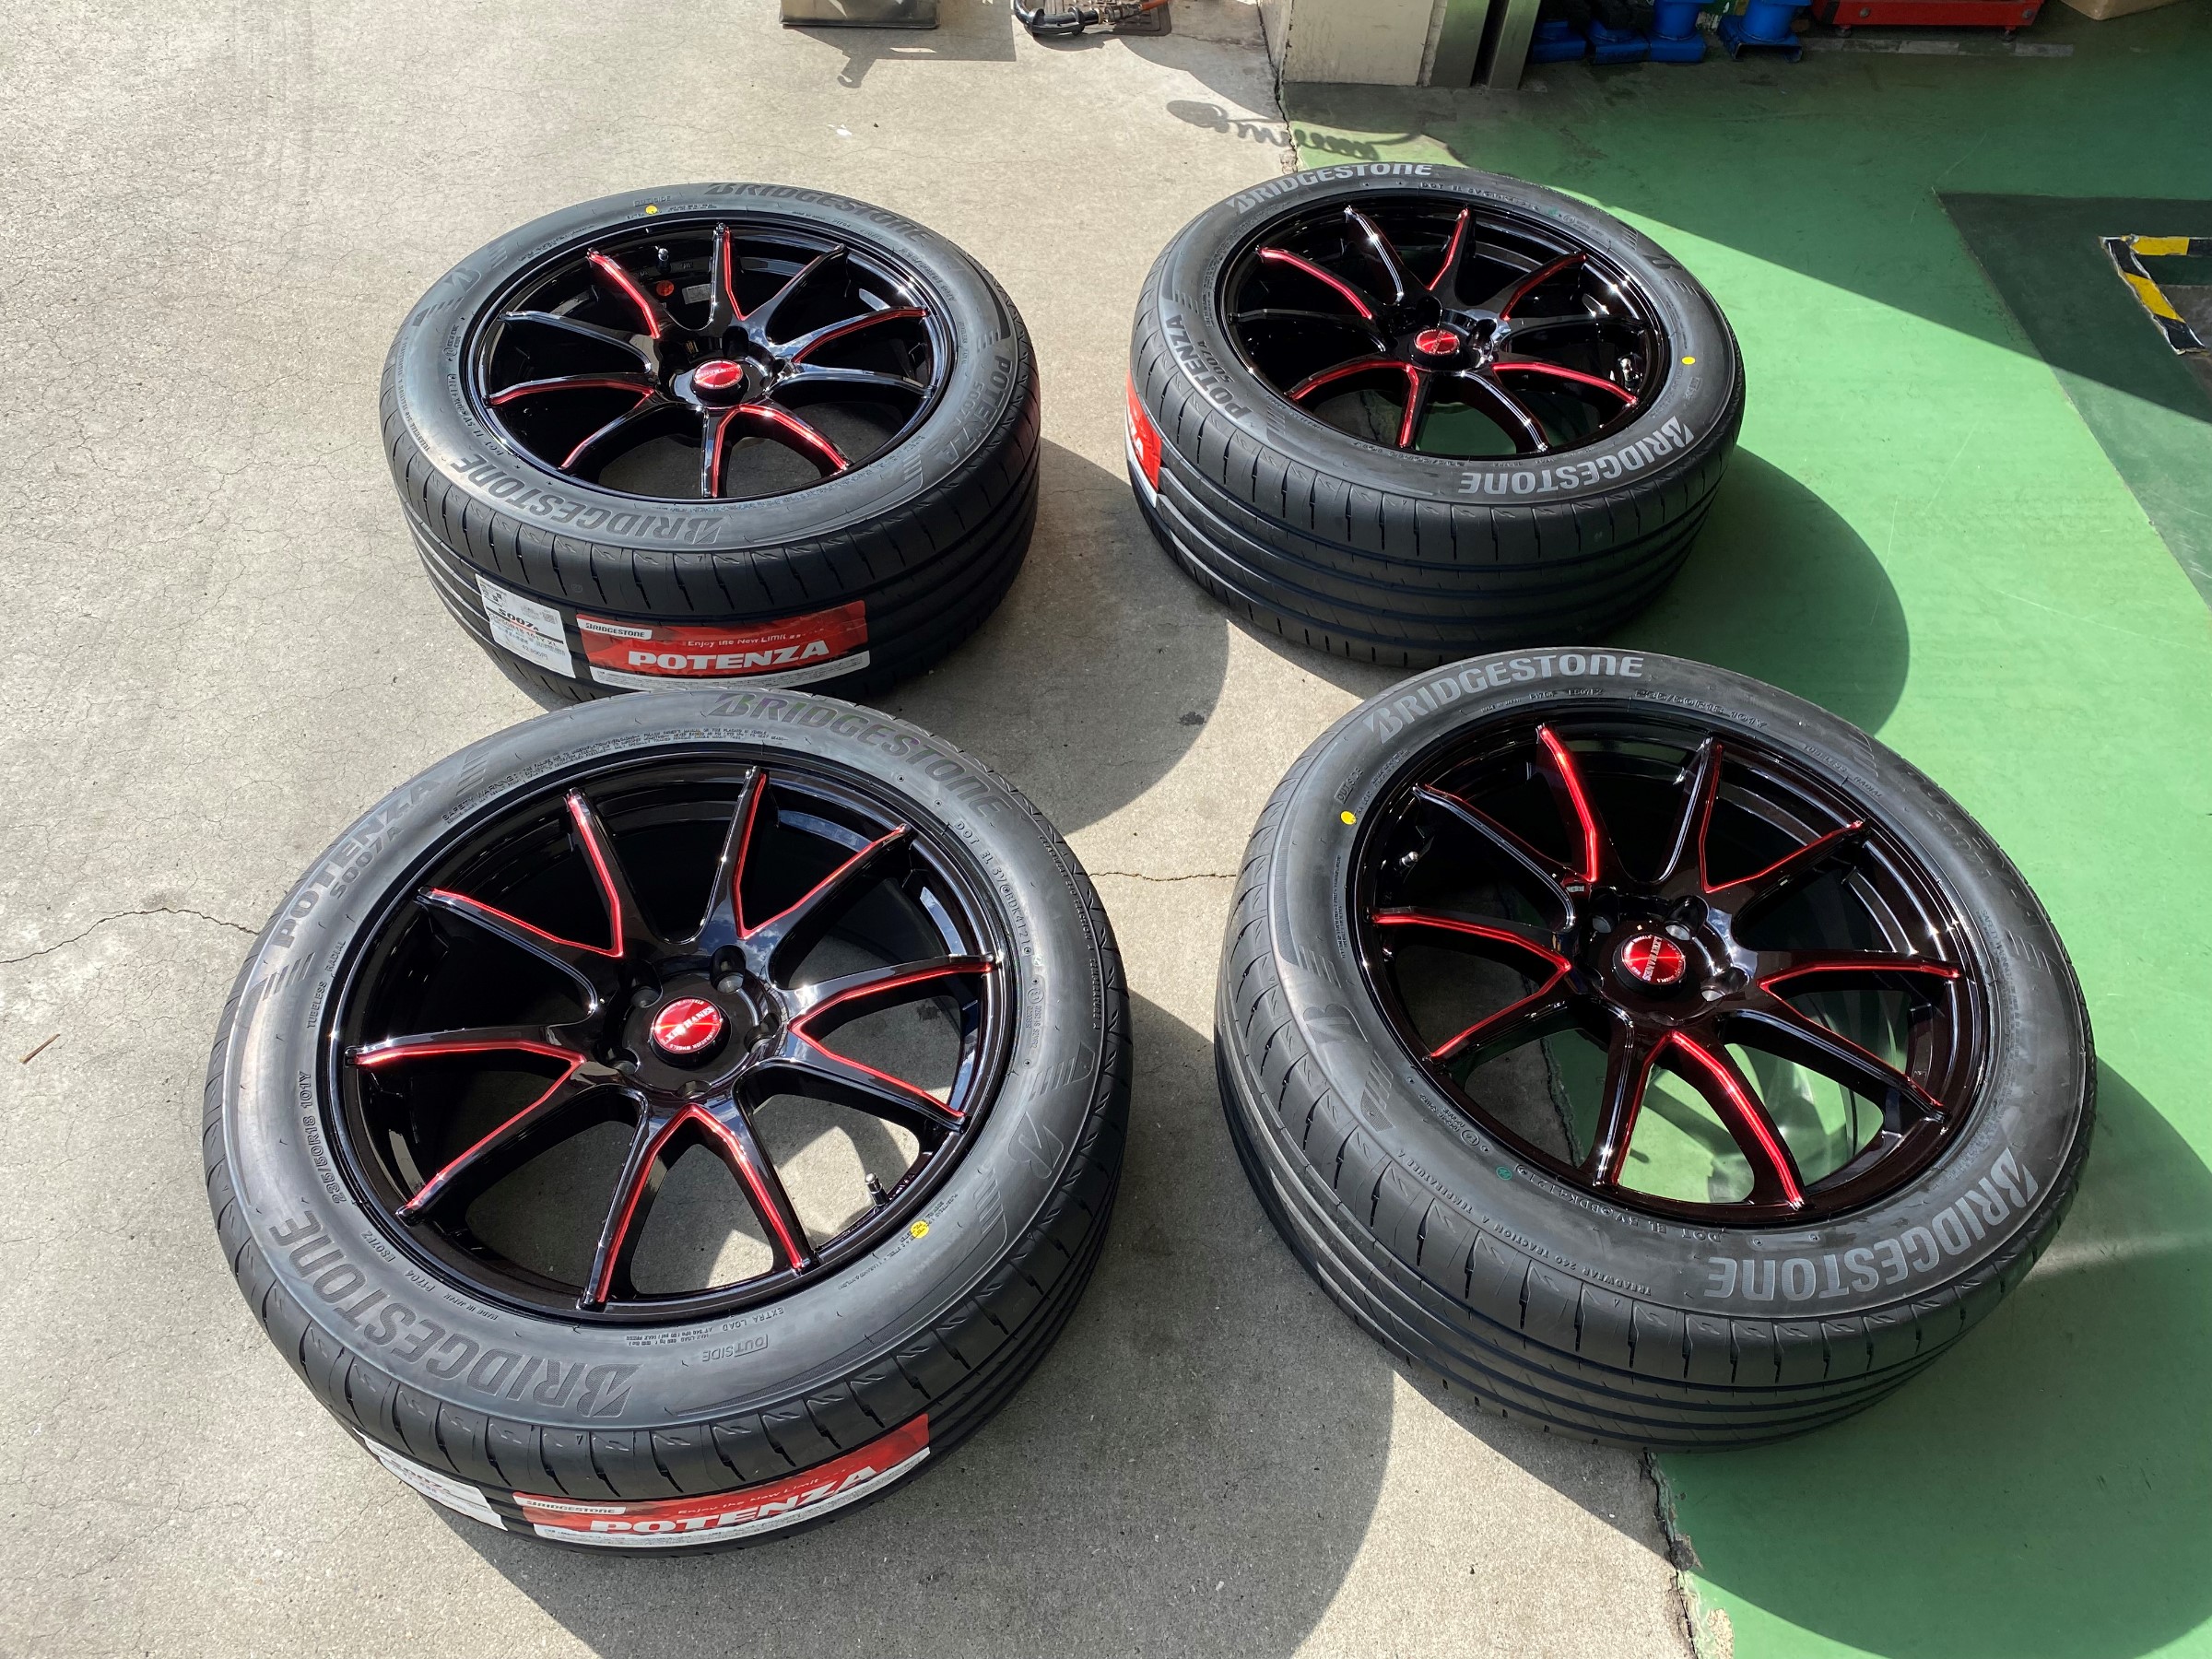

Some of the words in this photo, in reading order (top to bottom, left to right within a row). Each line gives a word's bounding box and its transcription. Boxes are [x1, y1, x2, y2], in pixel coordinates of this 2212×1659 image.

[704, 182, 935, 244] BRIDGESTONE
[1226, 163, 1433, 214] BRIDGESTONE
[1163, 313, 1254, 418] POTENZA
[1194, 340, 1236, 382] S007A
[935, 354, 1015, 469] POTENZA
[1458, 416, 1694, 496] BRIDGESTONE
[448, 455, 724, 545] BRIDGESTONE
[584, 622, 646, 638] BRIDGESTONE
[628, 640, 830, 670] POTENZA
[688, 640, 715, 649] Enjoy
[737, 636, 759, 645] New
[1360, 652, 1643, 746] BRIDGESTONE
[704, 690, 1013, 815] BRIDGESTONE
[439, 794, 477, 822] SAFETY
[950, 818, 982, 846] DOT
[265, 773, 441, 950] POTENZA
[324, 822, 405, 900] S007A
[1977, 908, 2002, 941] SAFETY
[303, 981, 328, 1028] TUBELESS
[322, 938, 347, 972] RADIAL
[297, 1069, 313, 1108] 101Y
[300, 1114, 347, 1205] 235/50R18
[1404, 1156, 1475, 1216] TEMPERATURE
[1490, 1220, 1551, 1260] TRACTION
[1679, 1226, 1723, 1243] DOT
[1702, 1144, 2040, 1304] BRIDGESTONE
[1552, 1253, 1578, 1272] 240
[1580, 1264, 1653, 1298] TREADWEAR
[266, 1213, 641, 1418] BRIDGESTONE
[720, 1316, 748, 1333] LOAD
[750, 1305, 785, 1324] EXTRA
[700, 1334, 765, 1364] OUTSIDE
[589, 1465, 877, 1532] POTENZA
